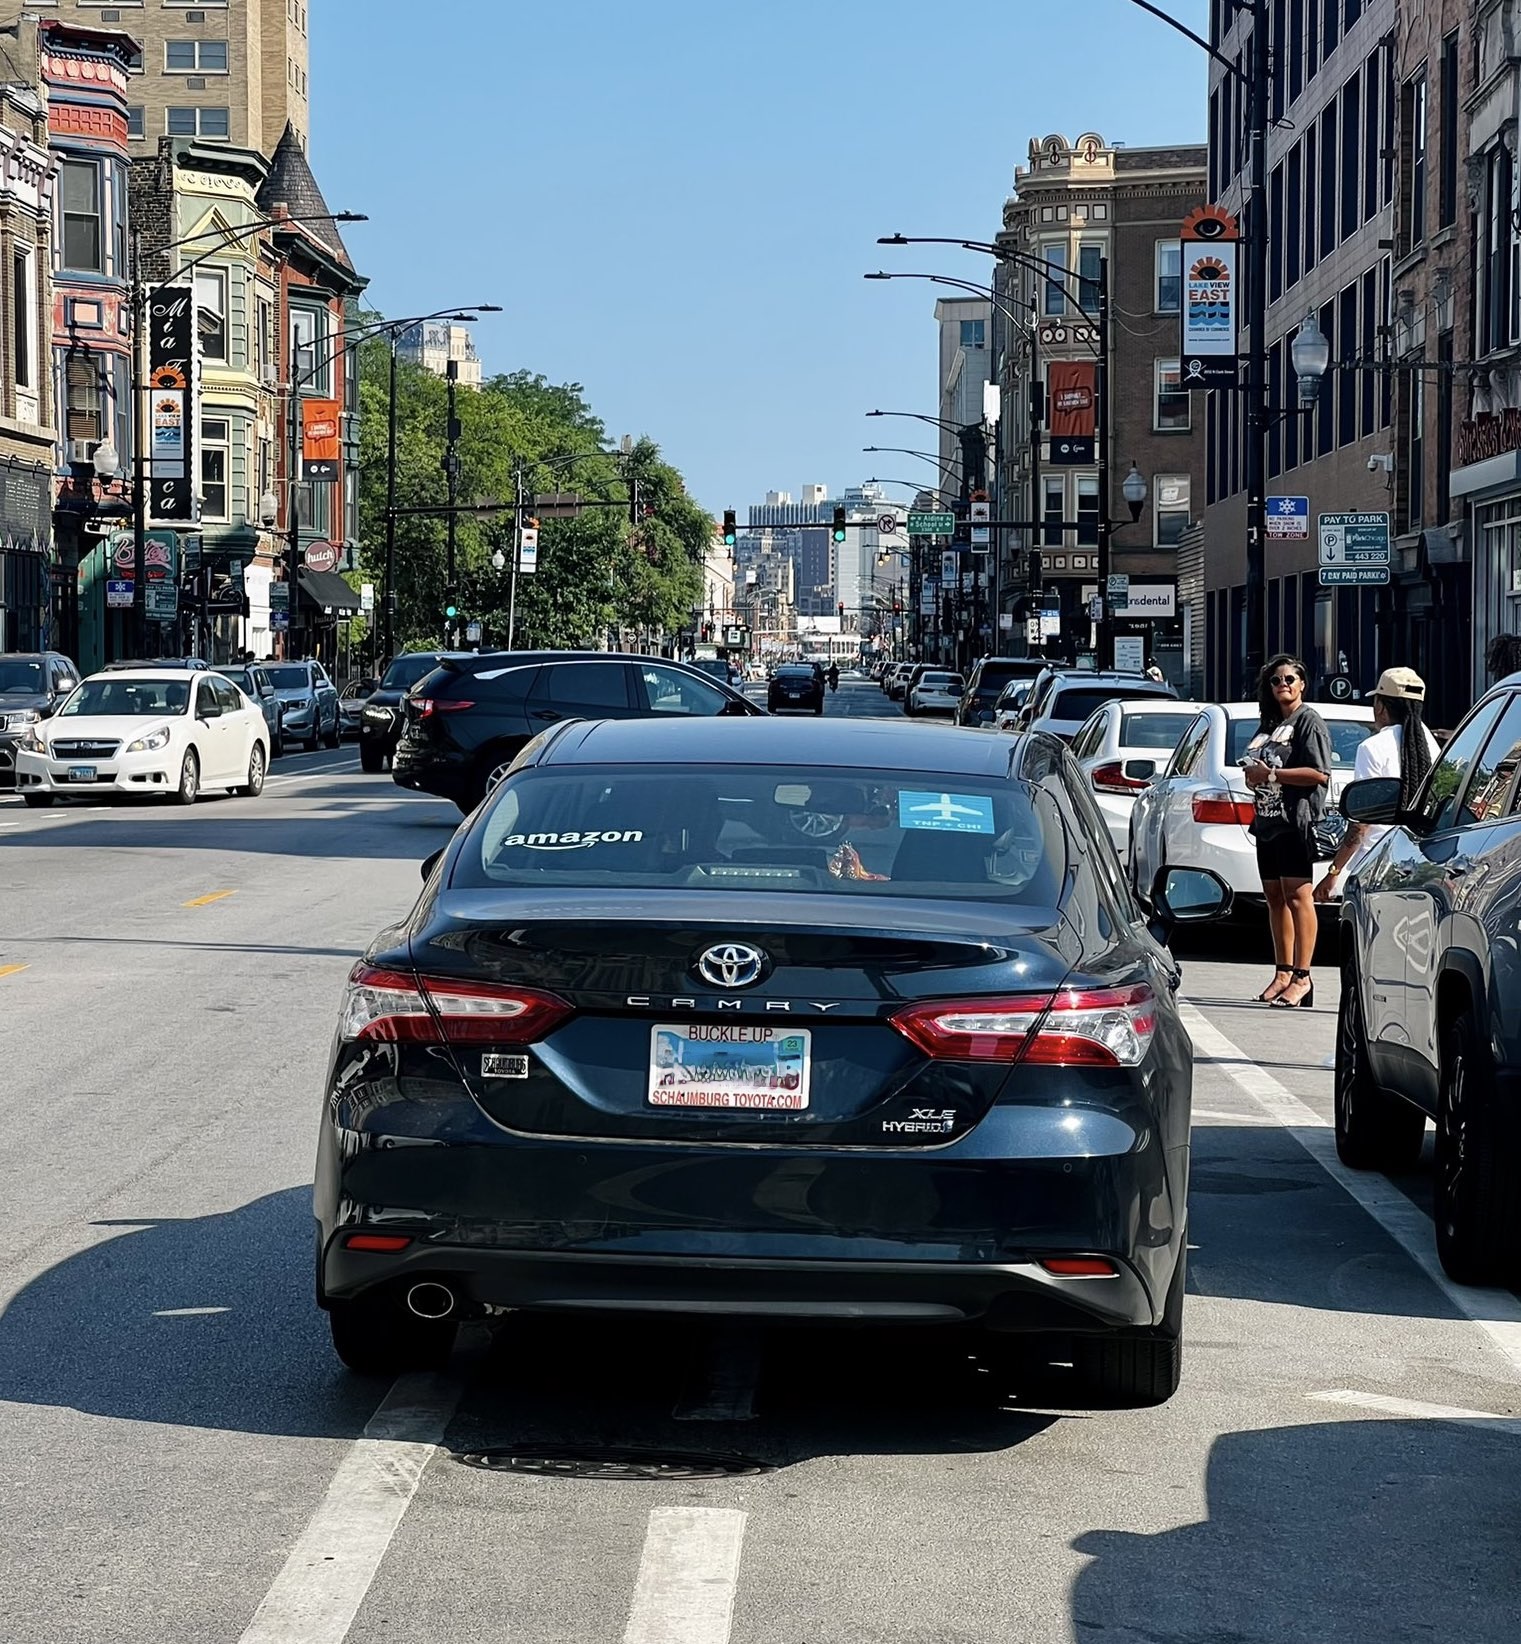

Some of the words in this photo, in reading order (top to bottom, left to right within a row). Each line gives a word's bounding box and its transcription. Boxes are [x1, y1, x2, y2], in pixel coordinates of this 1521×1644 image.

[1188, 289, 1230, 301] EAST
[155, 418, 181, 426] EAST
[1324, 515, 1342, 524] PAY
[1343, 515, 1356, 523] TO
[1358, 515, 1383, 523] PARK
[307, 549, 334, 563] hutch
[1370, 552, 1385, 560] 220
[1322, 572, 1327, 580] 7
[1328, 571, 1341, 580] DAY
[1342, 571, 1357, 580] PAID
[504, 830, 643, 848] amazon
[627, 996, 841, 1012] CAMRY
[688, 1025, 748, 1042] BUCKLE
[752, 1027, 773, 1043] UP
[786, 1039, 798, 1048] 23
[652, 1089, 730, 1107] SCHAUMBURG
[733, 1092, 802, 1109] TOYOTA.COM
[907, 1107, 957, 1120] XLE
[882, 1120, 941, 1133] HYBRID
